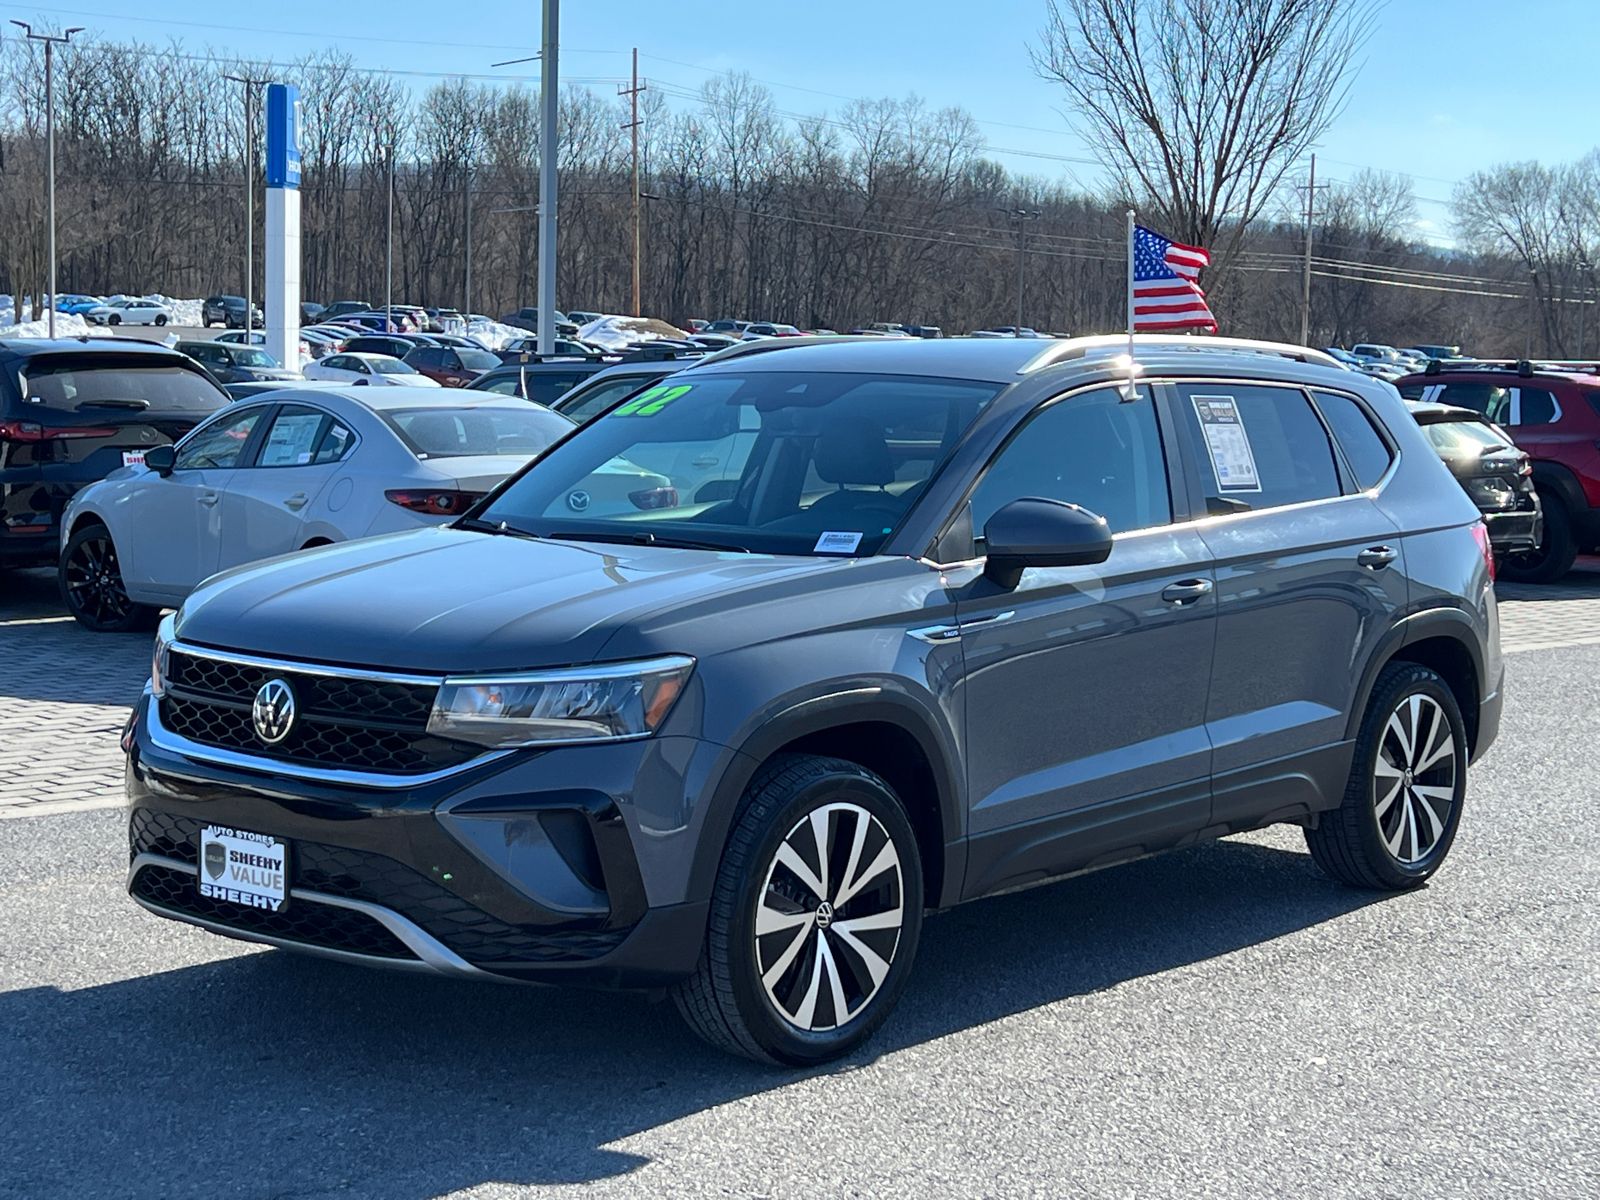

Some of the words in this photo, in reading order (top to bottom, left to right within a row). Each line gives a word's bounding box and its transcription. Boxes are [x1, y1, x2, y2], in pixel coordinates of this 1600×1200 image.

[614, 385, 692, 416] 22
[207, 825, 234, 838] AUTO
[236, 829, 275, 845] STORES
[229, 850, 282, 871] SHEEHY
[230, 865, 283, 891] VALUE
[200, 883, 282, 912] SHEEHY
